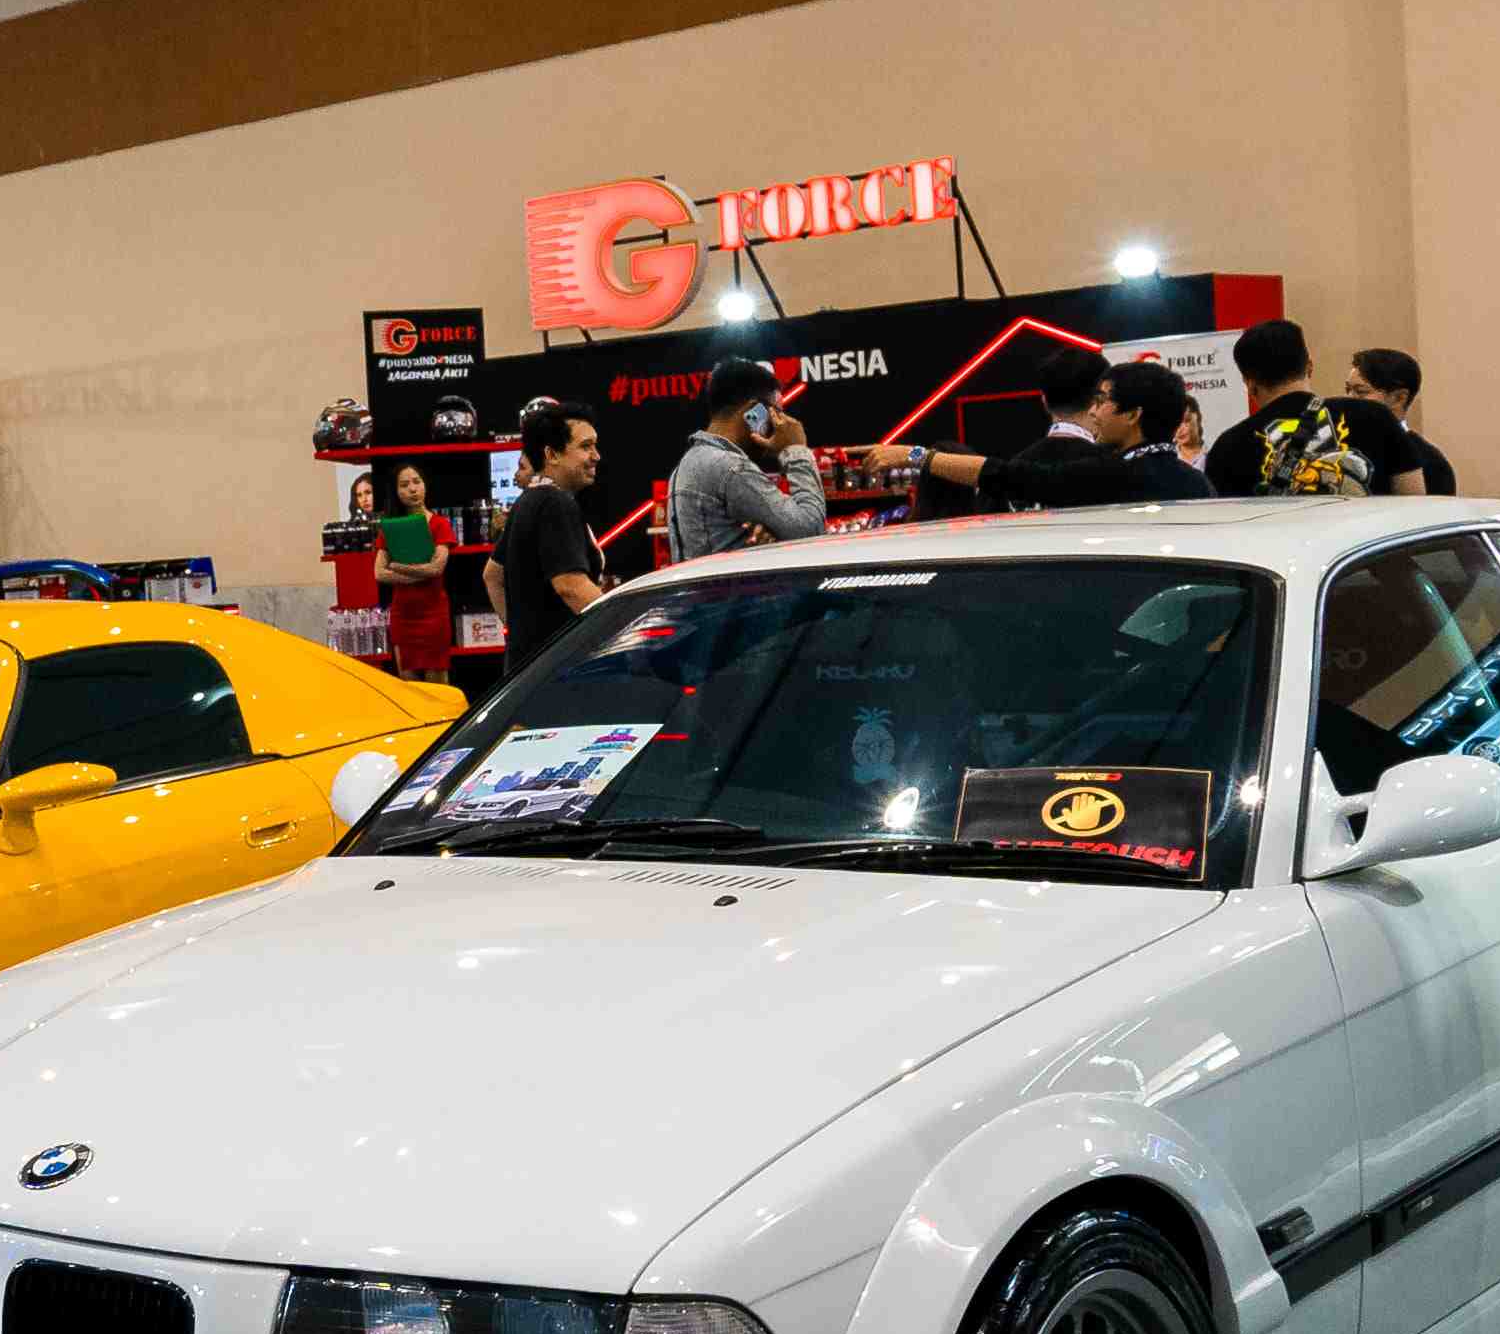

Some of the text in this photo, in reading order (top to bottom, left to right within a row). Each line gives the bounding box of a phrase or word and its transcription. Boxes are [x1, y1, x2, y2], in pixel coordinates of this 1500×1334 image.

[525, 153, 958, 332] G FORCE
[420, 324, 478, 344] FORCE
[1167, 353, 1216, 370] FORCE
